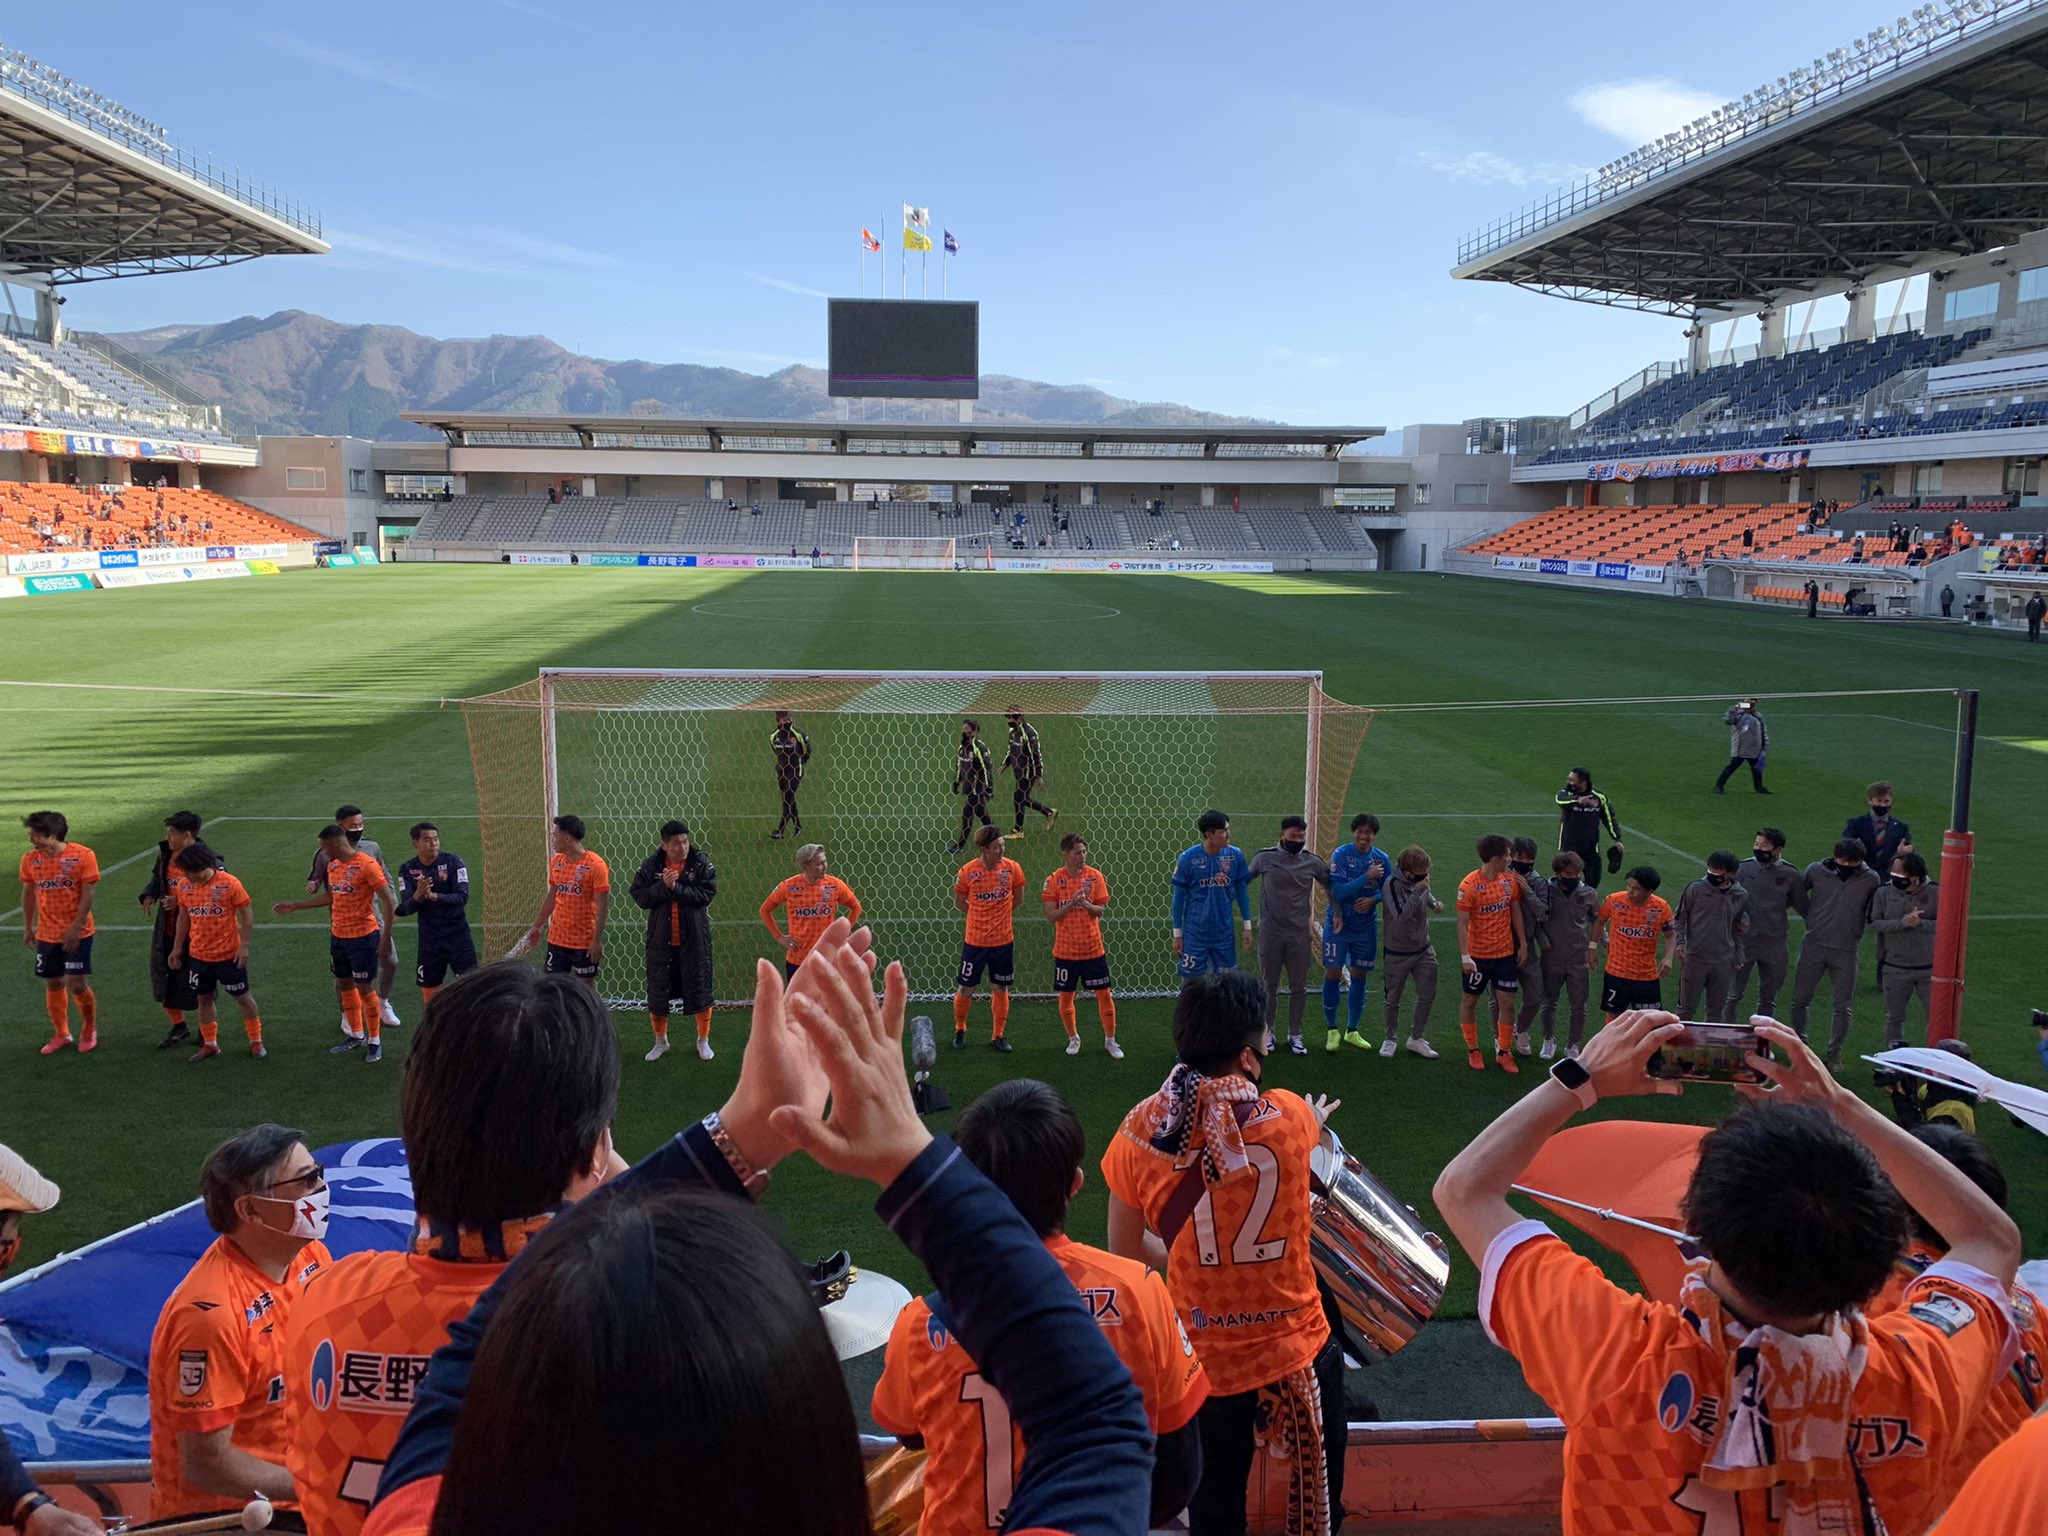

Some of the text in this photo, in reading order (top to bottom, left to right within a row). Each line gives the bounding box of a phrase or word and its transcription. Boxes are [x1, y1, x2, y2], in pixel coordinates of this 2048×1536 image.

[647, 556, 687, 566] 長野電子
[1177, 562, 1214, 571] トライアン
[795, 903, 831, 917] HOKTO
[1324, 942, 1337, 957] 31
[961, 961, 974, 977] 13
[1181, 953, 1196, 969] 35
[188, 970, 199, 987] 14
[1055, 967, 1069, 983] 10
[1468, 972, 1483, 986] 19
[1174, 1142, 1287, 1267] 12
[1848, 1416, 1926, 1458] ガス
